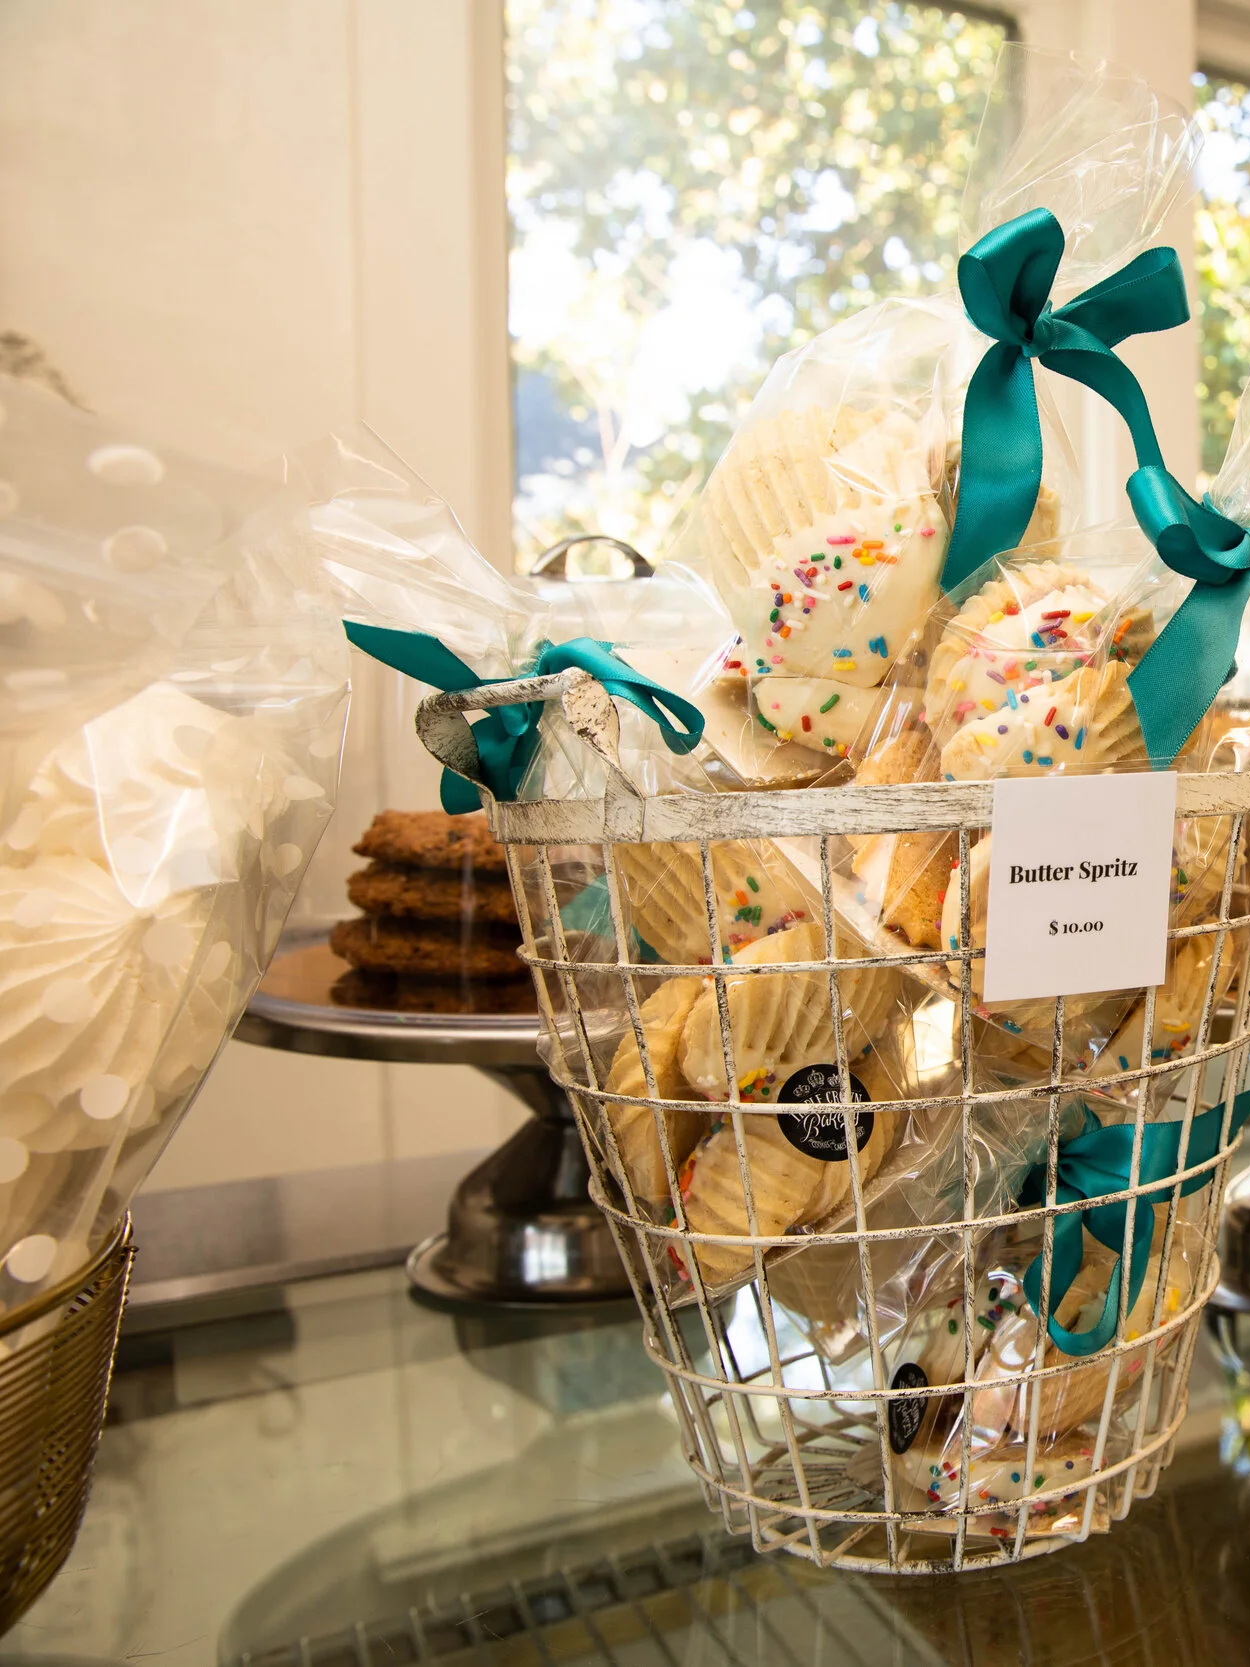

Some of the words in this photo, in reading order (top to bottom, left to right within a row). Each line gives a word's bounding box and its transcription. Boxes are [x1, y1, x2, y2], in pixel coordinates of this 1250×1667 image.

[1009, 864, 1074, 884] Butter
[1078, 858, 1138, 882] Spritz
[1048, 919, 1059, 936] $
[1062, 920, 1104, 935] 10.00
[789, 1094, 822, 1122] PLE
[825, 1090, 863, 1105] CRN
[801, 1112, 861, 1142] Bakey
